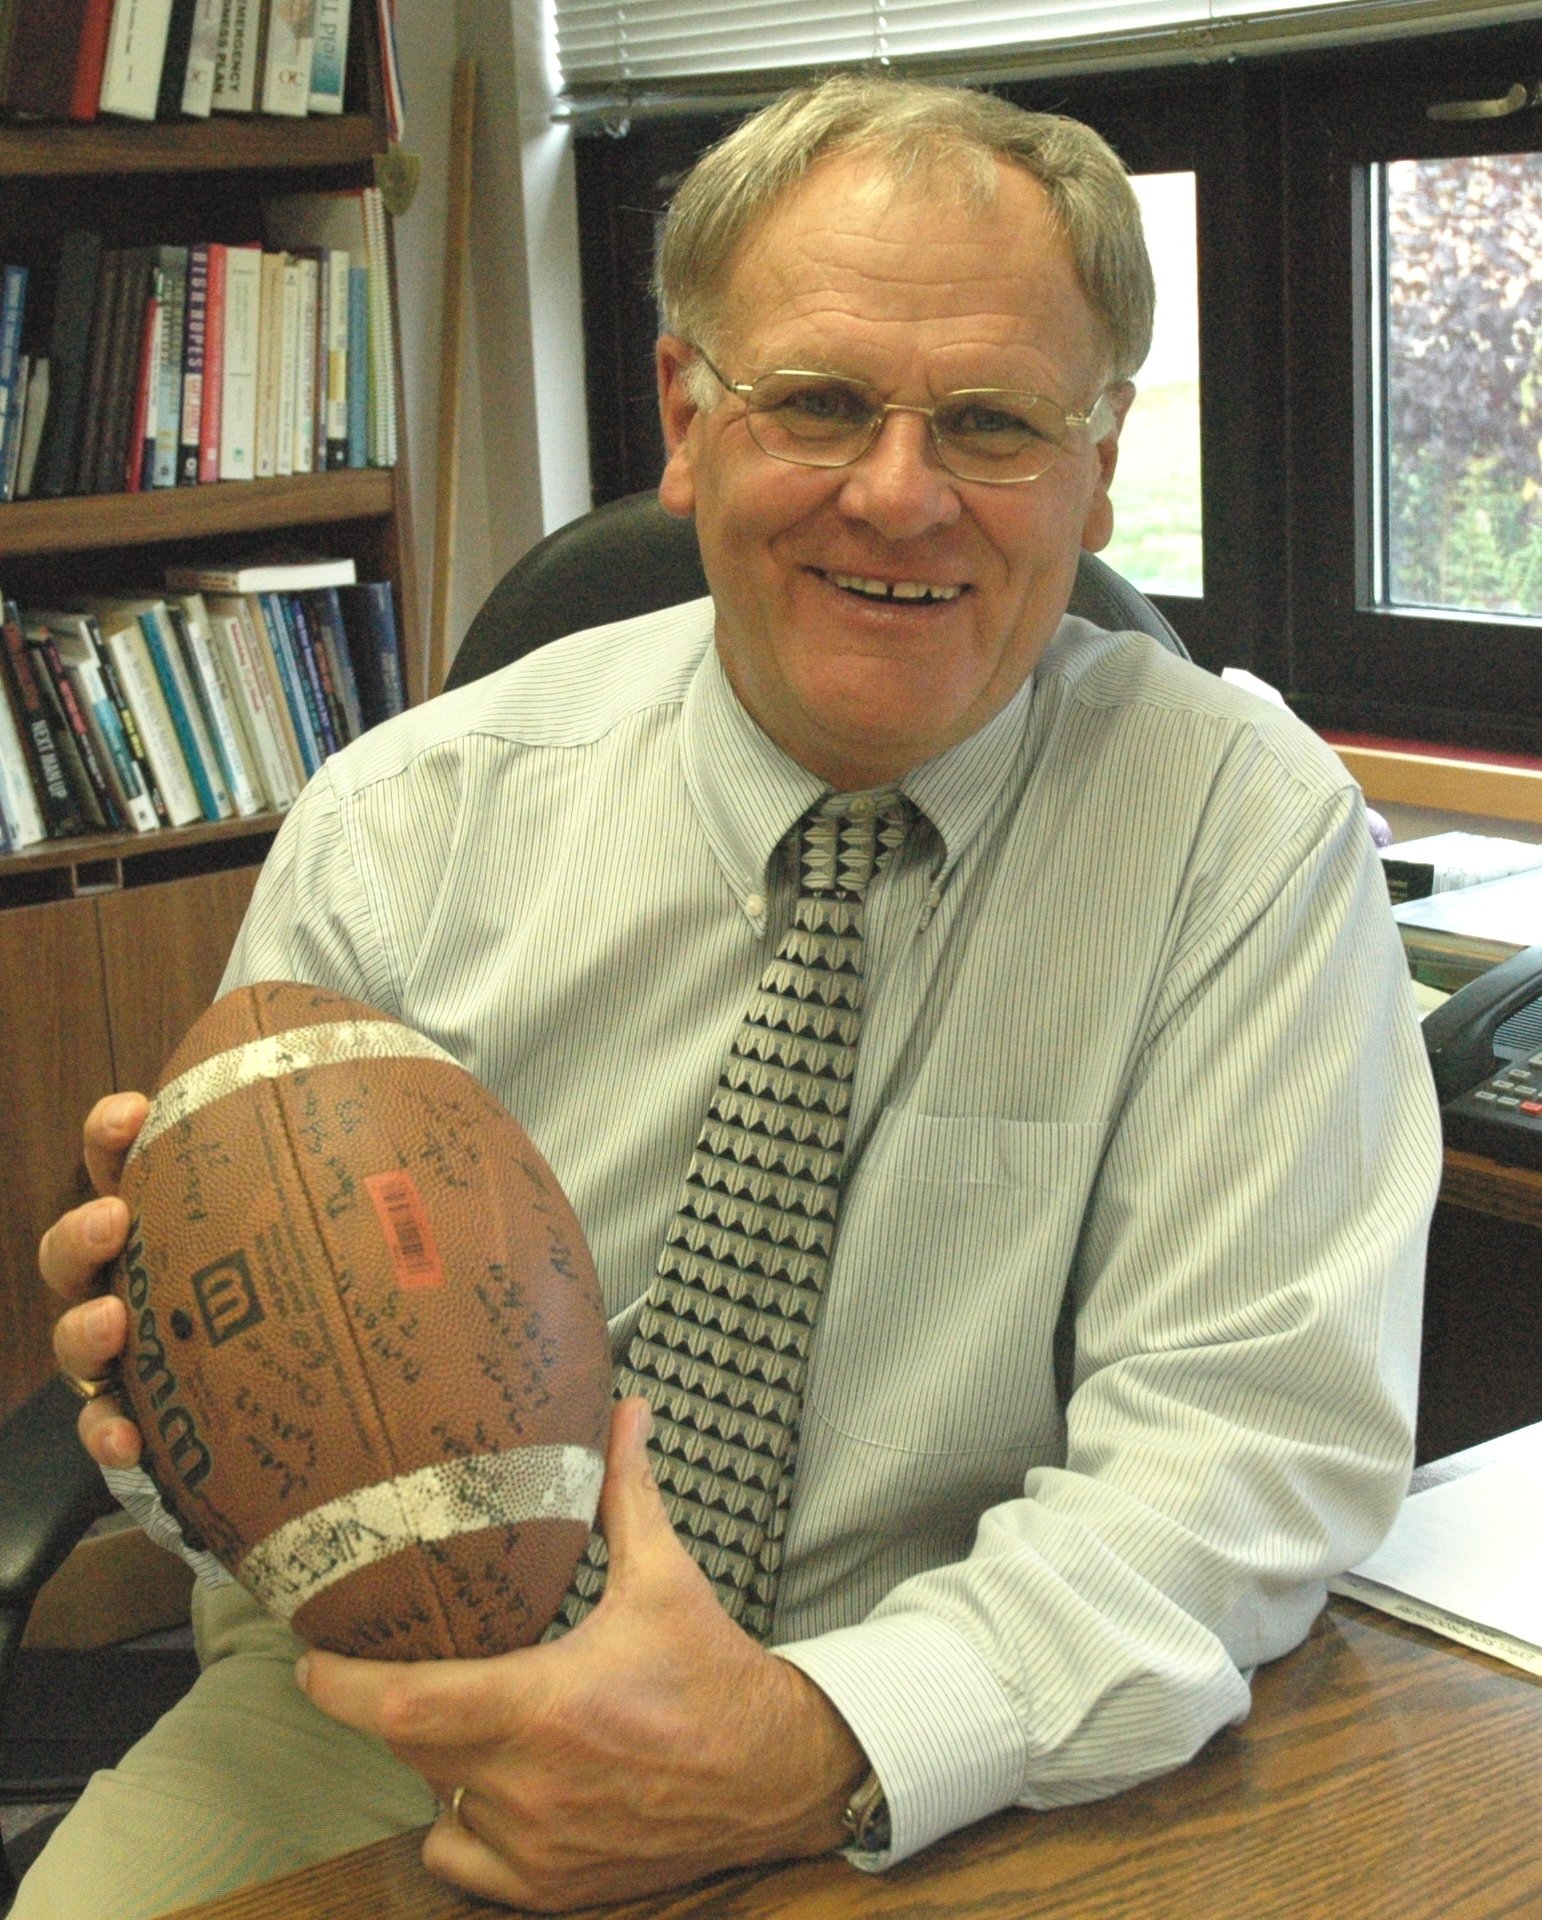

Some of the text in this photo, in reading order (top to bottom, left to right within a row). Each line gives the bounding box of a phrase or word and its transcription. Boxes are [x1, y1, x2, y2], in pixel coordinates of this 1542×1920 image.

[213, 53, 226, 94] PLAN
[191, 252, 208, 302] HIGH
[187, 310, 206, 368] HOPES
[32, 719, 68, 799] NEXT MAN UP
[126, 1214, 213, 1498] Wilson
